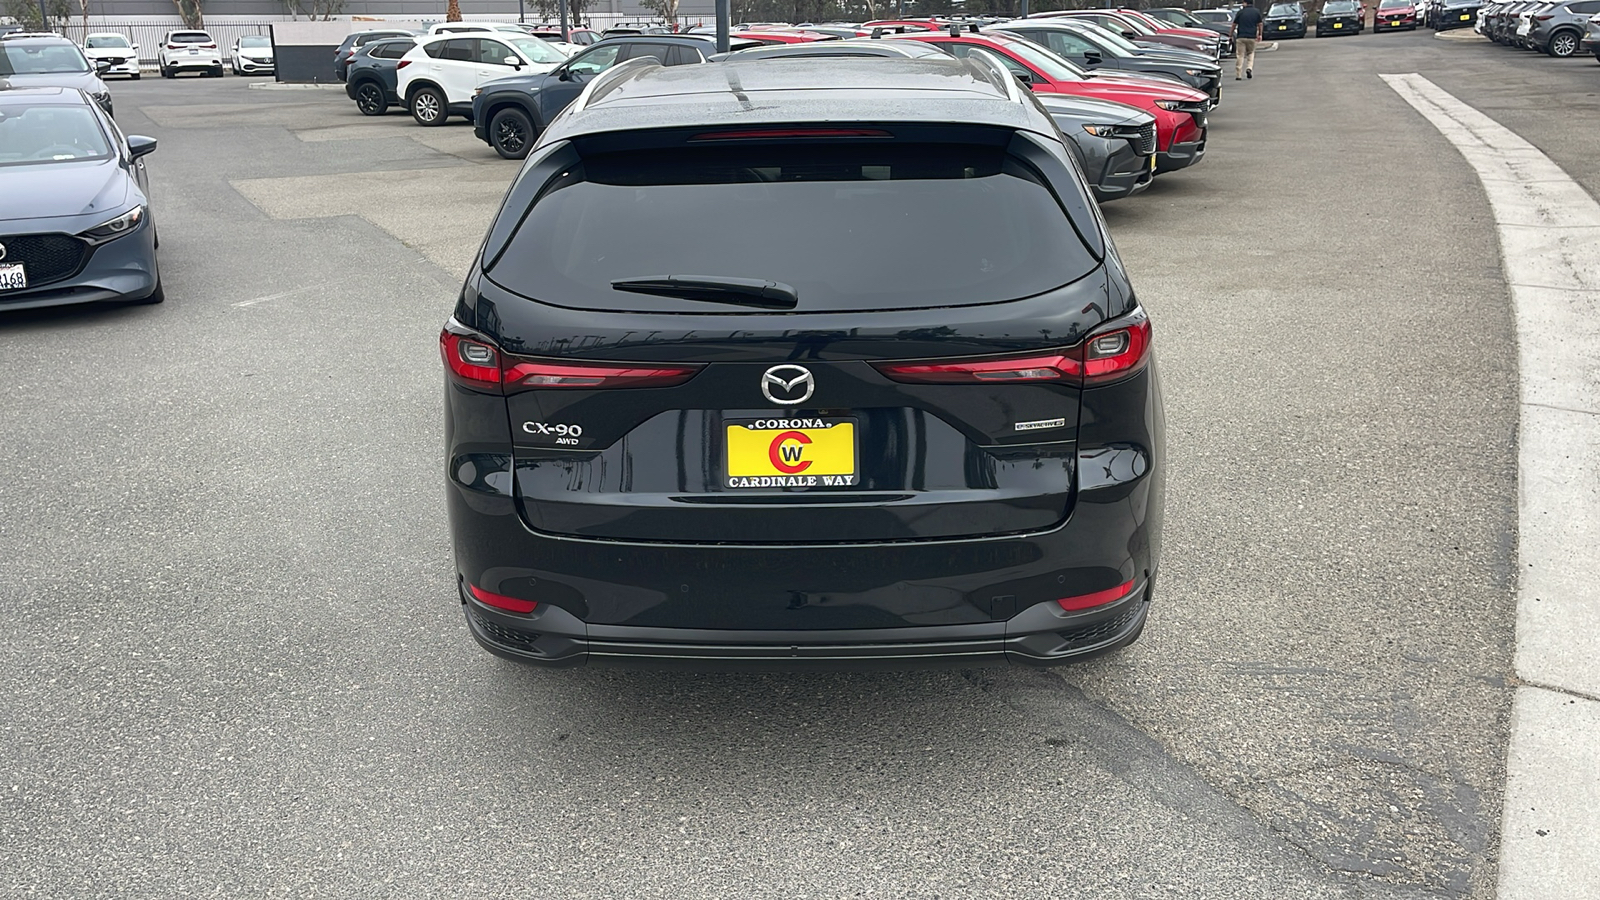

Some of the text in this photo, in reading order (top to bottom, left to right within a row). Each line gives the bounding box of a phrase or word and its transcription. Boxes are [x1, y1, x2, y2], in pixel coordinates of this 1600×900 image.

[0, 272, 24, 284] 168
[522, 421, 582, 437] CX-90
[755, 418, 825, 429] CORONA
[555, 437, 579, 445] AWD
[728, 475, 854, 487] CARDINALE WAY
